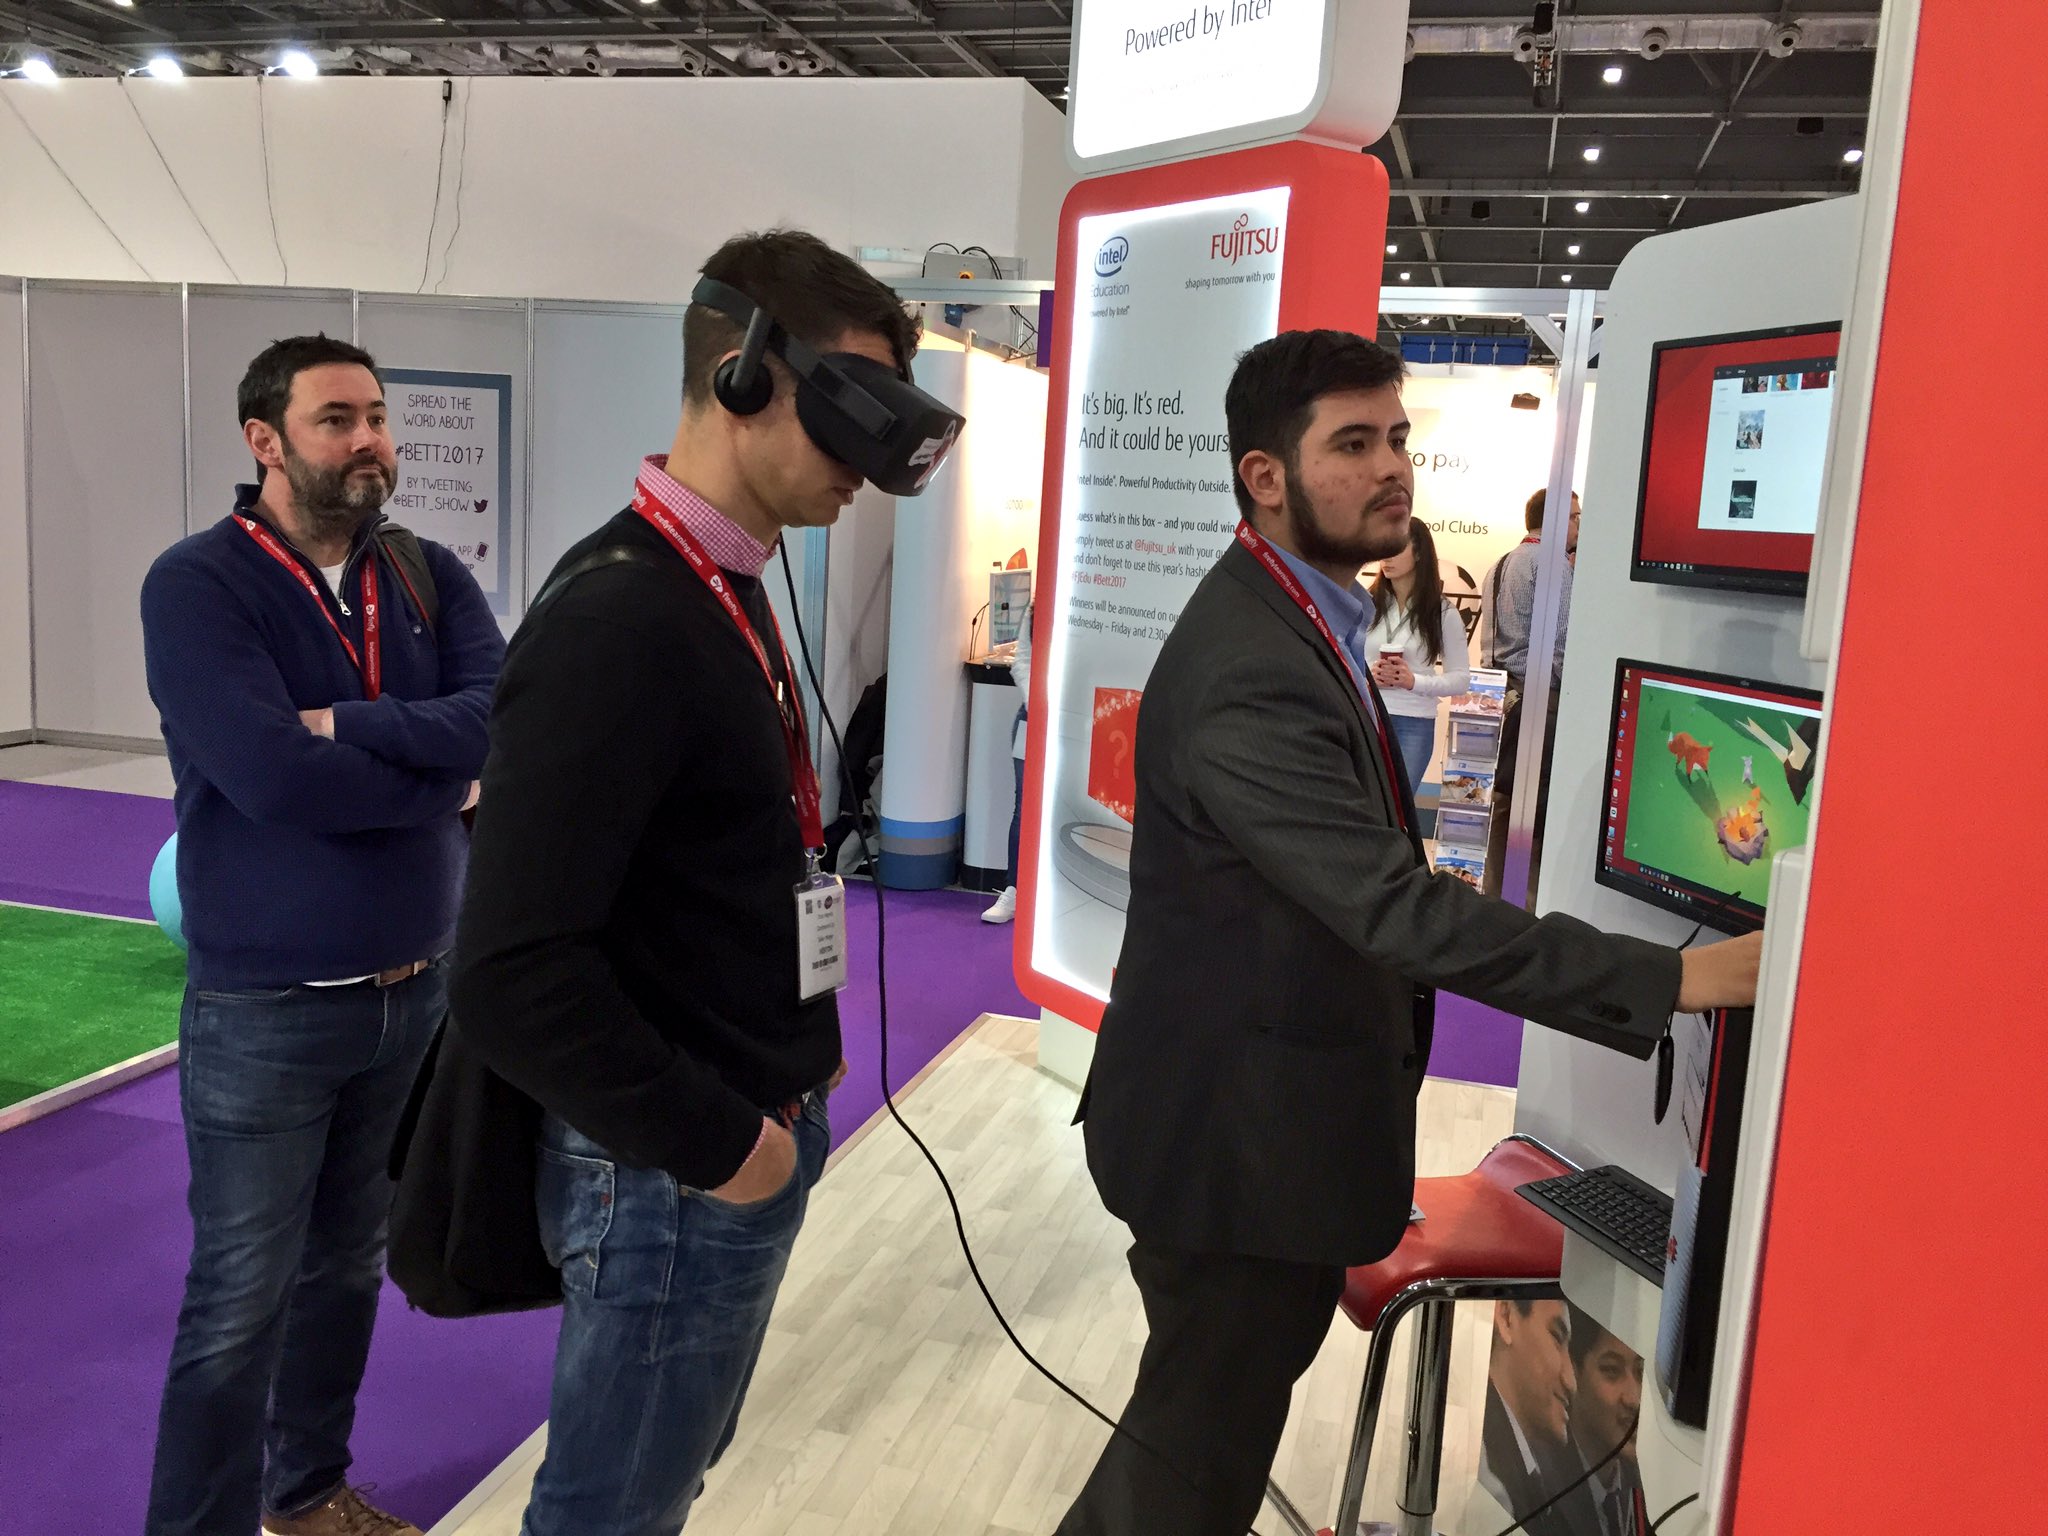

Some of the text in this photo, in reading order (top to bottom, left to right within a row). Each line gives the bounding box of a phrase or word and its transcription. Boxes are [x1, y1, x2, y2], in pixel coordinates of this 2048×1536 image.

[1126, 8, 1196, 56] Powered
[1203, 5, 1225, 40] by
[1098, 245, 1123, 265] intel
[1211, 227, 1279, 266] FUJITSU
[1091, 284, 1130, 297] ducation
[1184, 271, 1276, 291] shaping tomorrow with you
[408, 394, 472, 411] SPREAD THE
[1104, 391, 1128, 422] big.
[1133, 390, 1152, 415] It's
[1157, 390, 1184, 415] red.
[403, 413, 475, 430] WORD ABOUT
[1079, 425, 1105, 449] And
[1109, 427, 1119, 449] it
[1123, 426, 1160, 450] could
[1165, 426, 1183, 451] be
[395, 442, 484, 465] #BETT2017
[1433, 453, 1471, 473] pay
[407, 476, 473, 493] BY TWEETING
[1077, 475, 1092, 486] ntel
[1119, 475, 1150, 489] Powerful
[1152, 477, 1196, 495] Productivity
[1199, 480, 1231, 493] Outside.
[393, 494, 470, 512] @BETT_SHOW
[1077, 512, 1094, 522] uess
[1095, 511, 1117, 524] what's
[1119, 513, 1126, 525] in
[1127, 514, 1140, 526] this
[1142, 515, 1156, 527] box
[1163, 516, 1179, 529] and
[1180, 520, 1195, 533] you
[1197, 520, 1219, 533] could
[1220, 521, 1236, 533] win
[1449, 520, 1489, 535] Clubs
[652, 511, 703, 567] fireflylearning.com
[1076, 534, 1094, 549] mply
[1095, 536, 1114, 548] tweet
[1116, 540, 1124, 549] us
[1125, 539, 1133, 550] at
[1178, 543, 1194, 556] with
[1196, 547, 1214, 560] your
[457, 545, 473, 556] APP
[1103, 555, 1123, 571] forget
[1124, 558, 1132, 569] to
[1133, 561, 1146, 571] use
[1147, 560, 1161, 573] this
[1162, 563, 1183, 577] year's
[1262, 551, 1300, 598] fireflylearning.com
[1093, 573, 1127, 588] #Bett2017
[722, 591, 739, 616] firefly
[1095, 600, 1107, 613] will
[1108, 601, 1117, 614] be
[1118, 605, 1156, 621] announced
[1157, 611, 1167, 621] on
[1067, 614, 1104, 633] Wednesday
[1111, 621, 1131, 638] Friday
[1132, 626, 1147, 638] and
